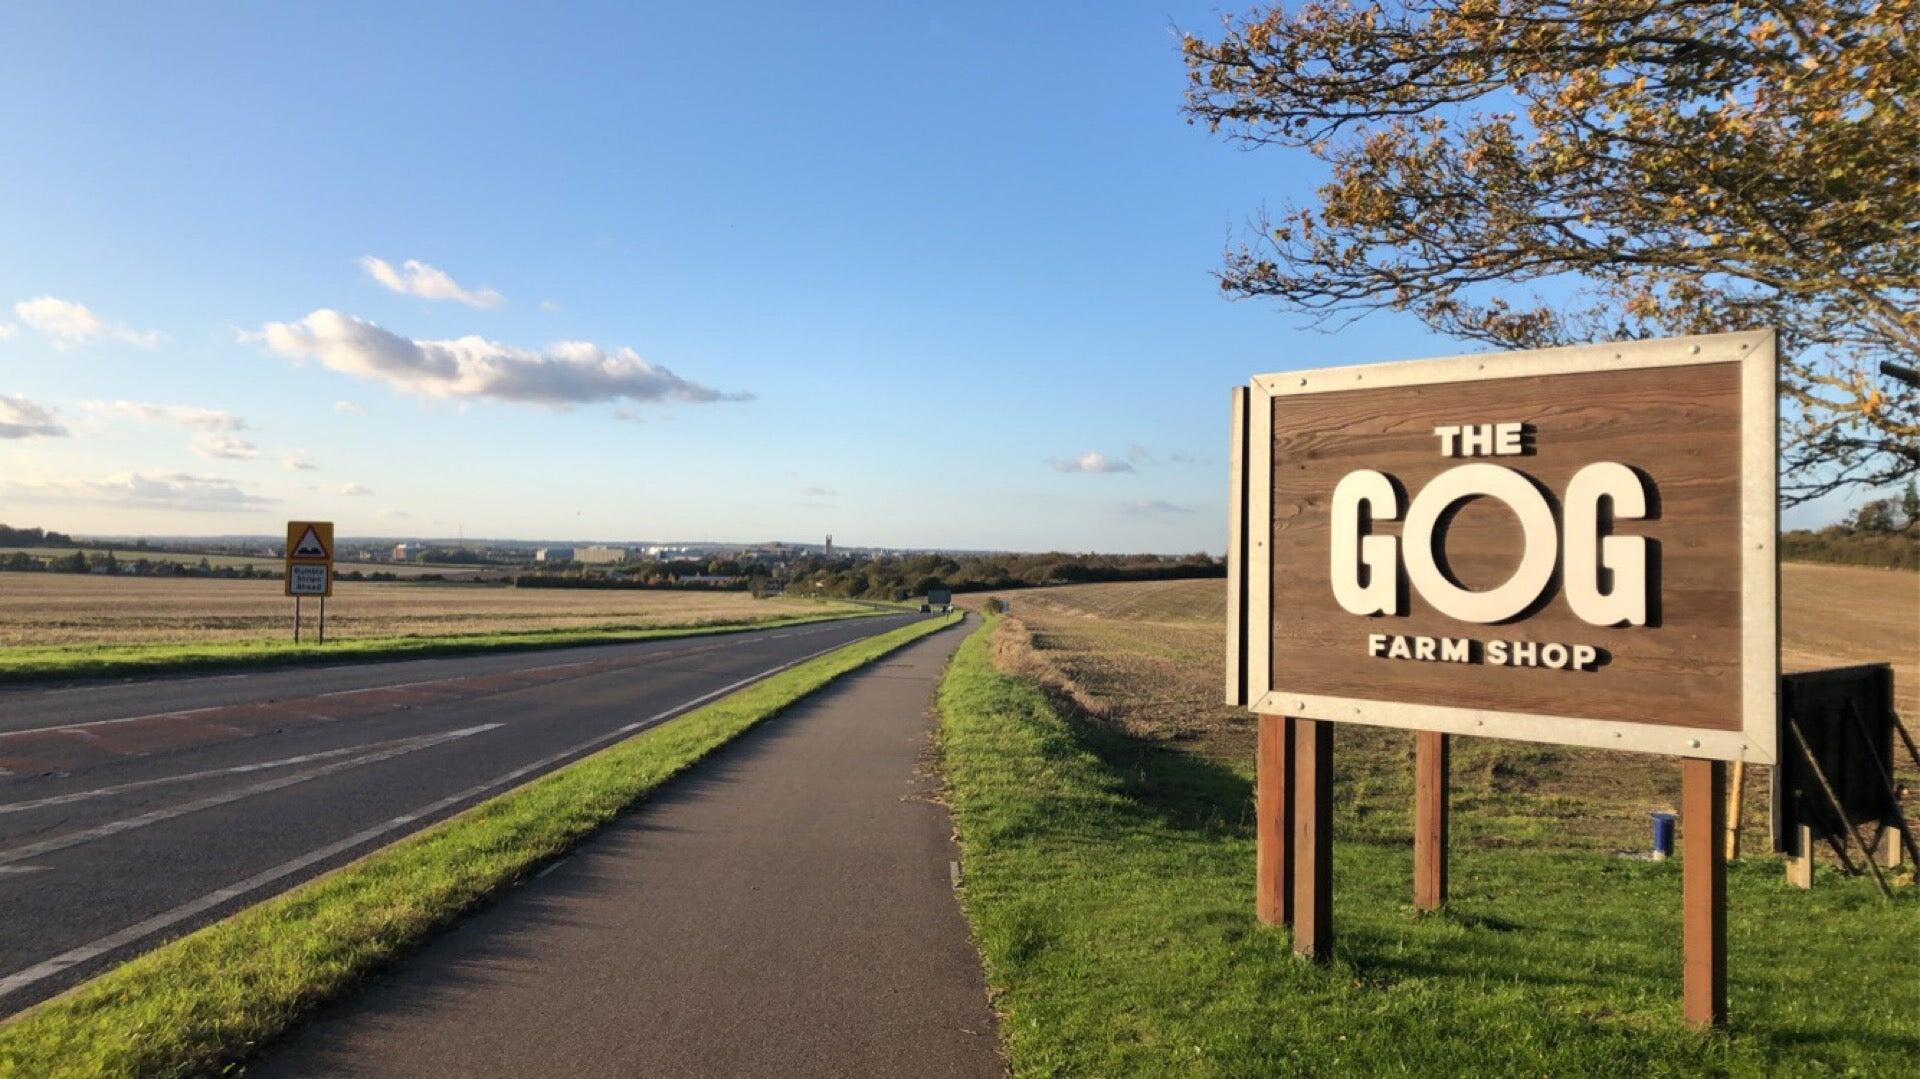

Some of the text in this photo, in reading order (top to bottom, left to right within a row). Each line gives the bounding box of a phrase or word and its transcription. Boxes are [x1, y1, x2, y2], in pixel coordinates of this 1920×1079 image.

[1434, 422, 1522, 457] THE
[1331, 461, 1646, 626] GOG
[1368, 633, 1597, 671] FARM SHOP
